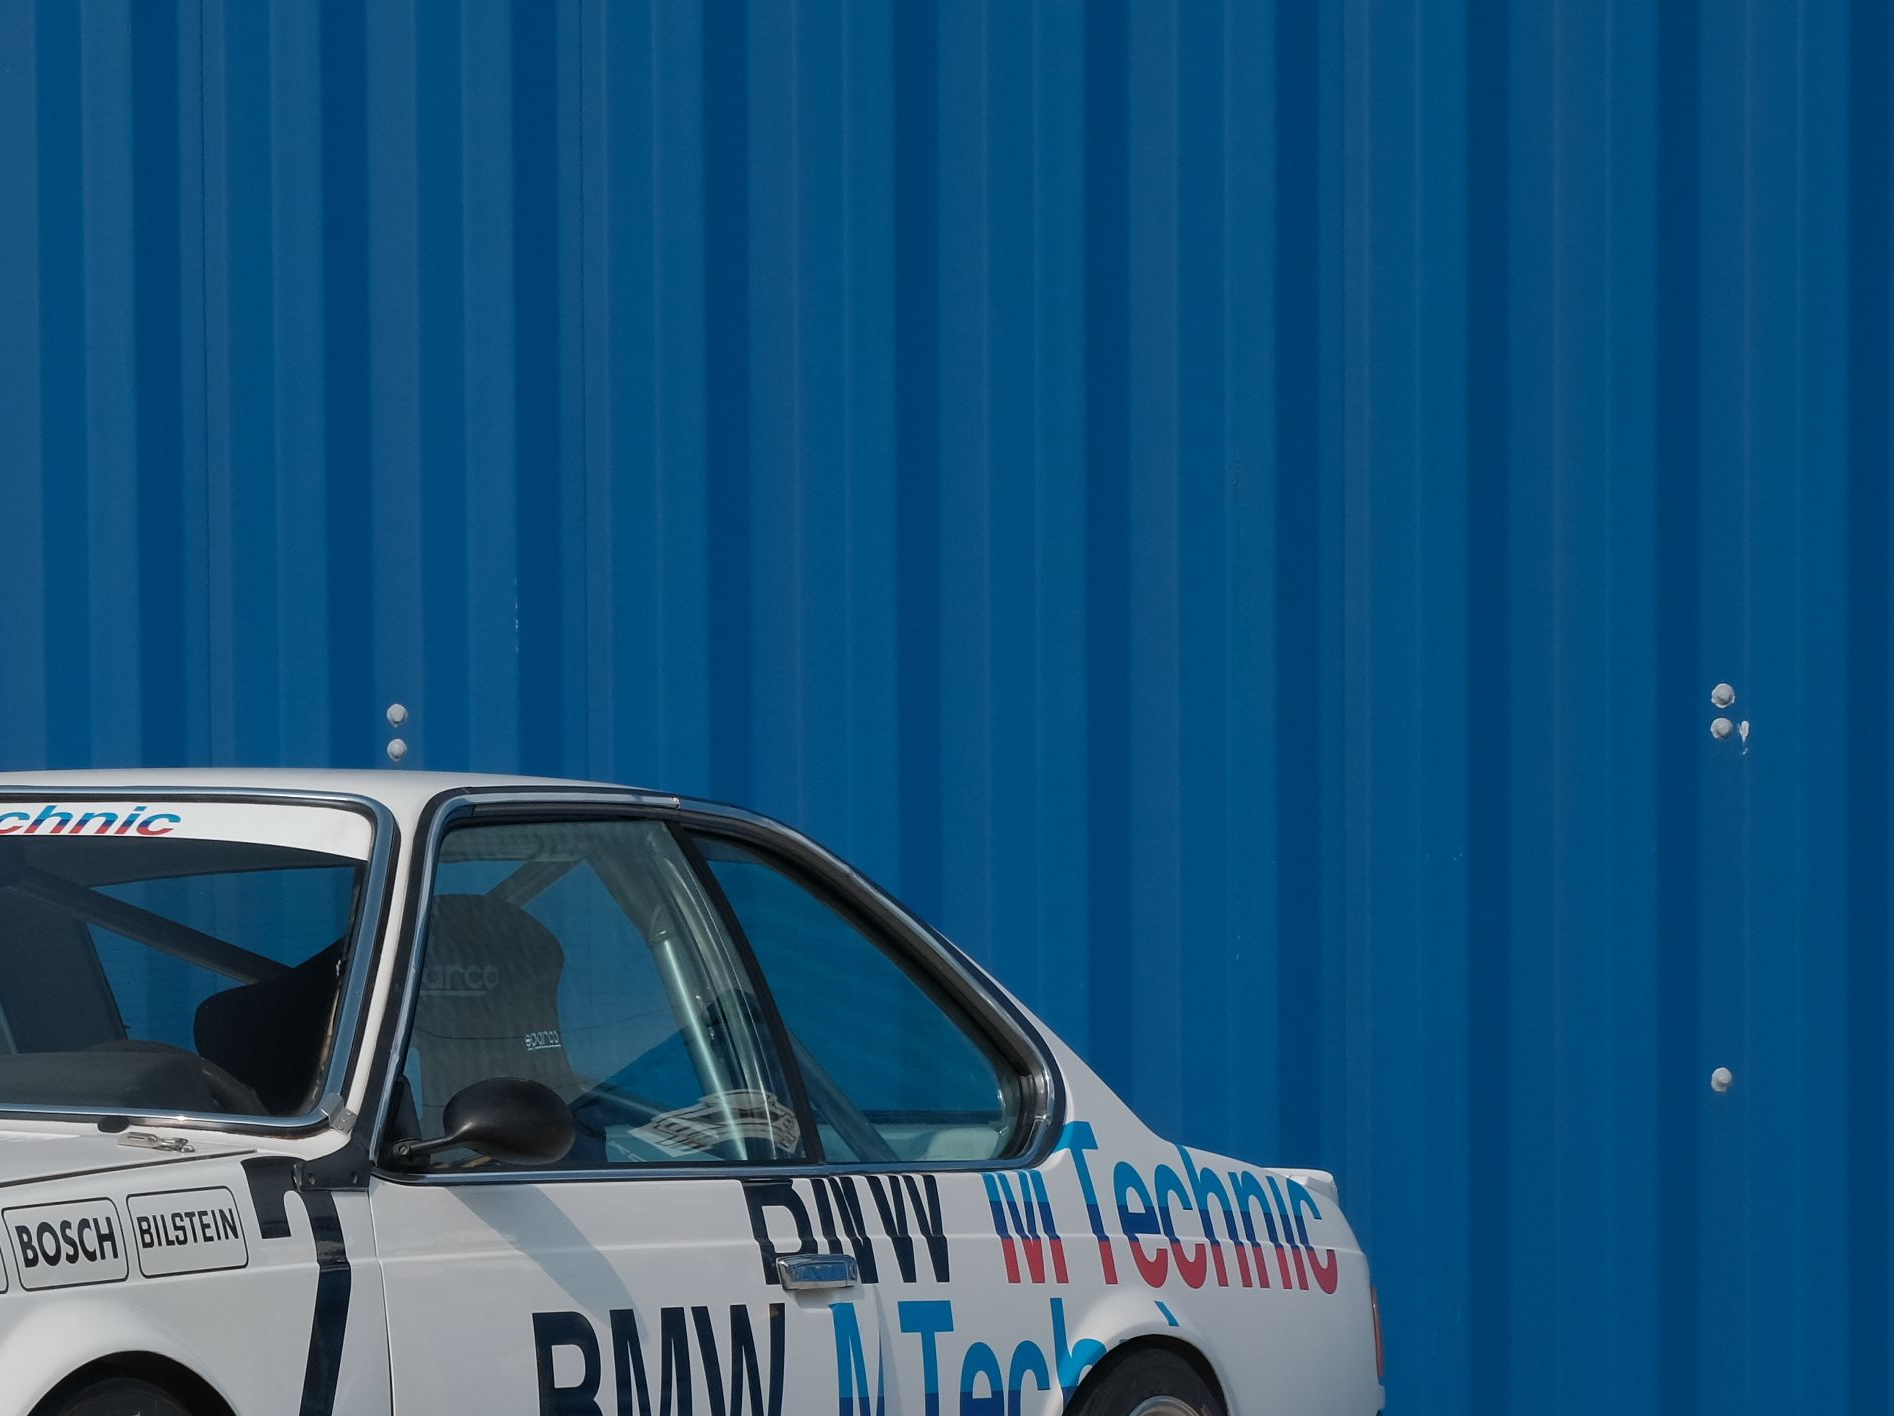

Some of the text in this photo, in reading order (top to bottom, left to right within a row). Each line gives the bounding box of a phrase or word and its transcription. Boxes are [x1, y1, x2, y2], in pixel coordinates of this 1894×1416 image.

[422, 963, 500, 991] arco
[135, 1207, 240, 1250] BILSTEIN
[740, 1120, 1339, 1295] BMW M Technic
[15, 1215, 119, 1268] BOSCH
